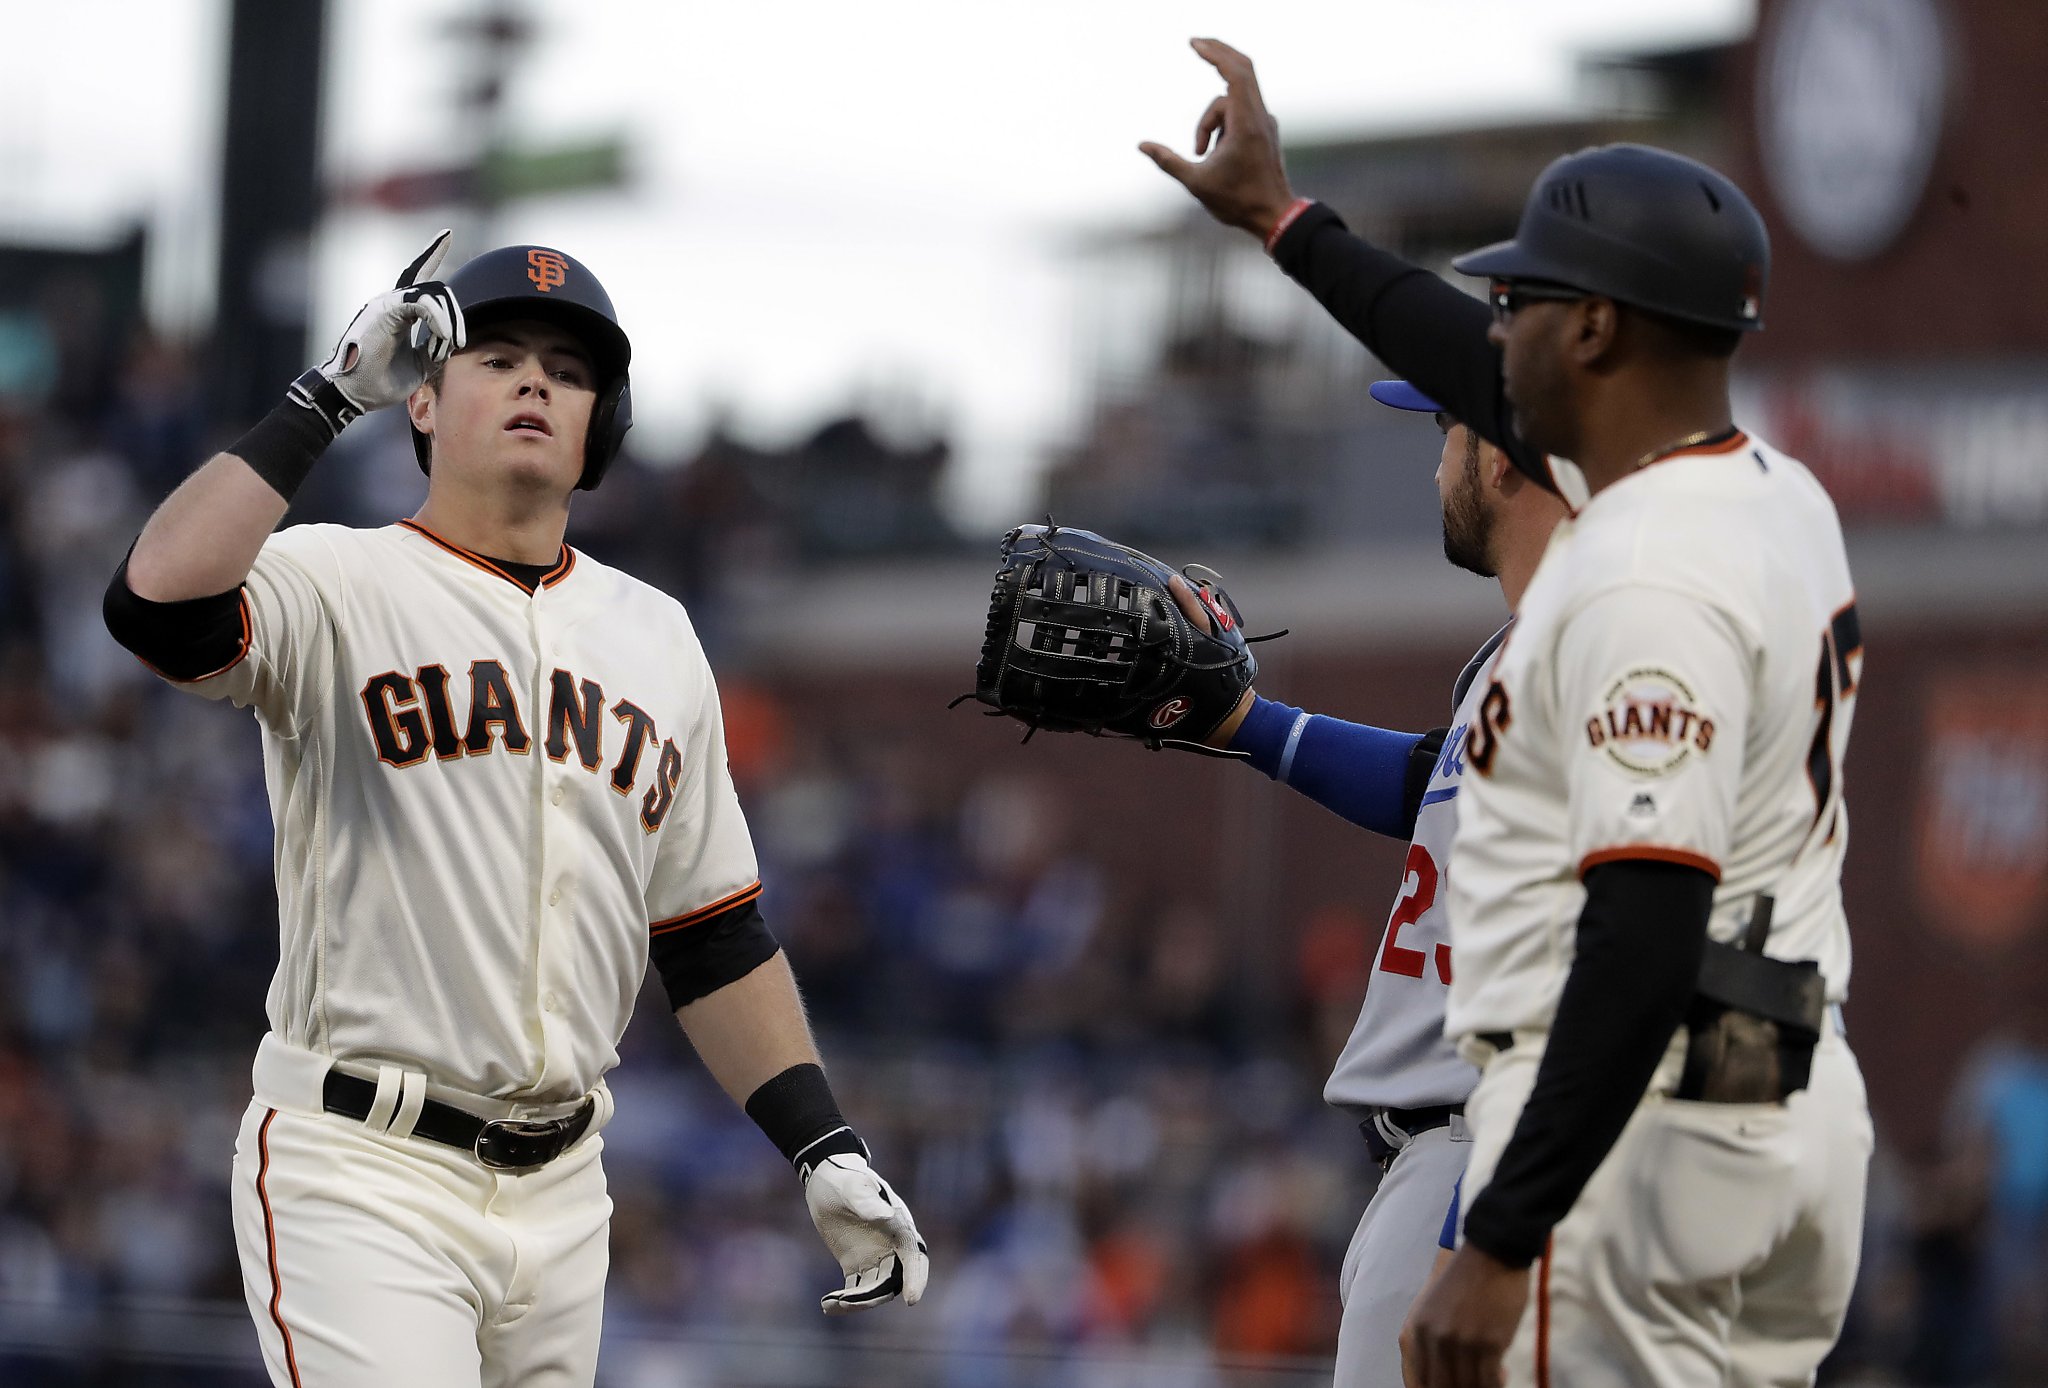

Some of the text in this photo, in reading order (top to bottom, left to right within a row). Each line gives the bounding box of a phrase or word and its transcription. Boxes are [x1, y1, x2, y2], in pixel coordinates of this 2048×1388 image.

[527, 249, 569, 293] SF
[360, 659, 682, 836] GIANTS
[1585, 705, 1715, 753] GIANTS
